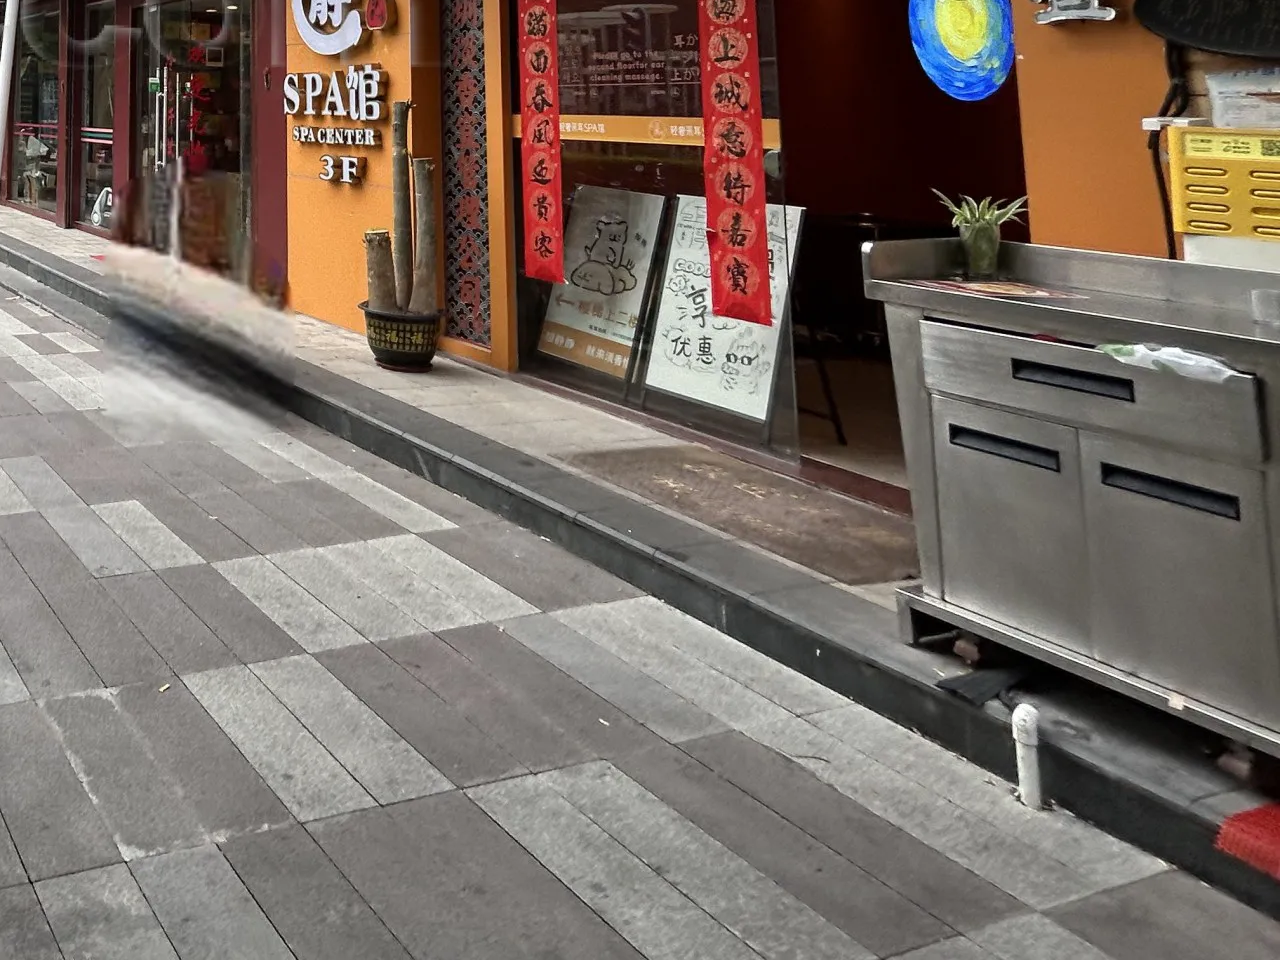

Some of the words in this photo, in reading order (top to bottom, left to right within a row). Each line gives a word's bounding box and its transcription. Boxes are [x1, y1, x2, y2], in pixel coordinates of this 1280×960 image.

[283, 63, 381, 122] SPA馆
[293, 126, 315, 143] SPA
[317, 127, 376, 146] CENTER
[670, 335, 717, 365] 优惠
